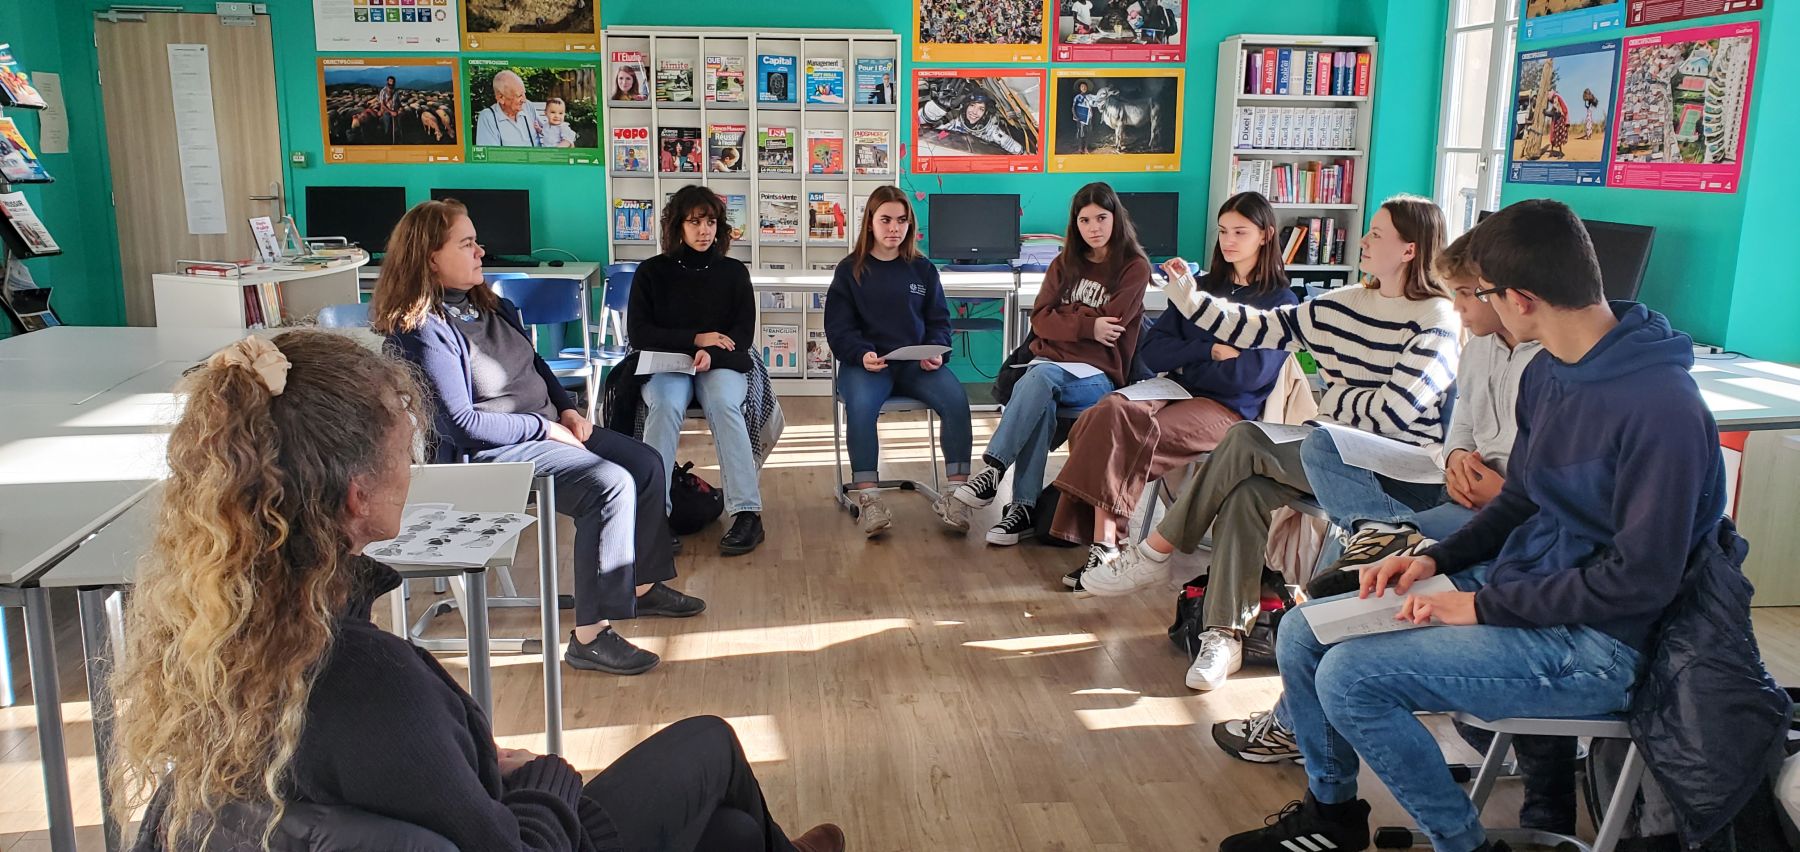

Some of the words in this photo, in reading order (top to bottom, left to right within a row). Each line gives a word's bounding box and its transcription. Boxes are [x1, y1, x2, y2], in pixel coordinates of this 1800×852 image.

[660, 61, 689, 71] Limite
[763, 56, 791, 66] Capital
[614, 129, 648, 139] TOPO
[715, 133, 739, 141] Réussir
